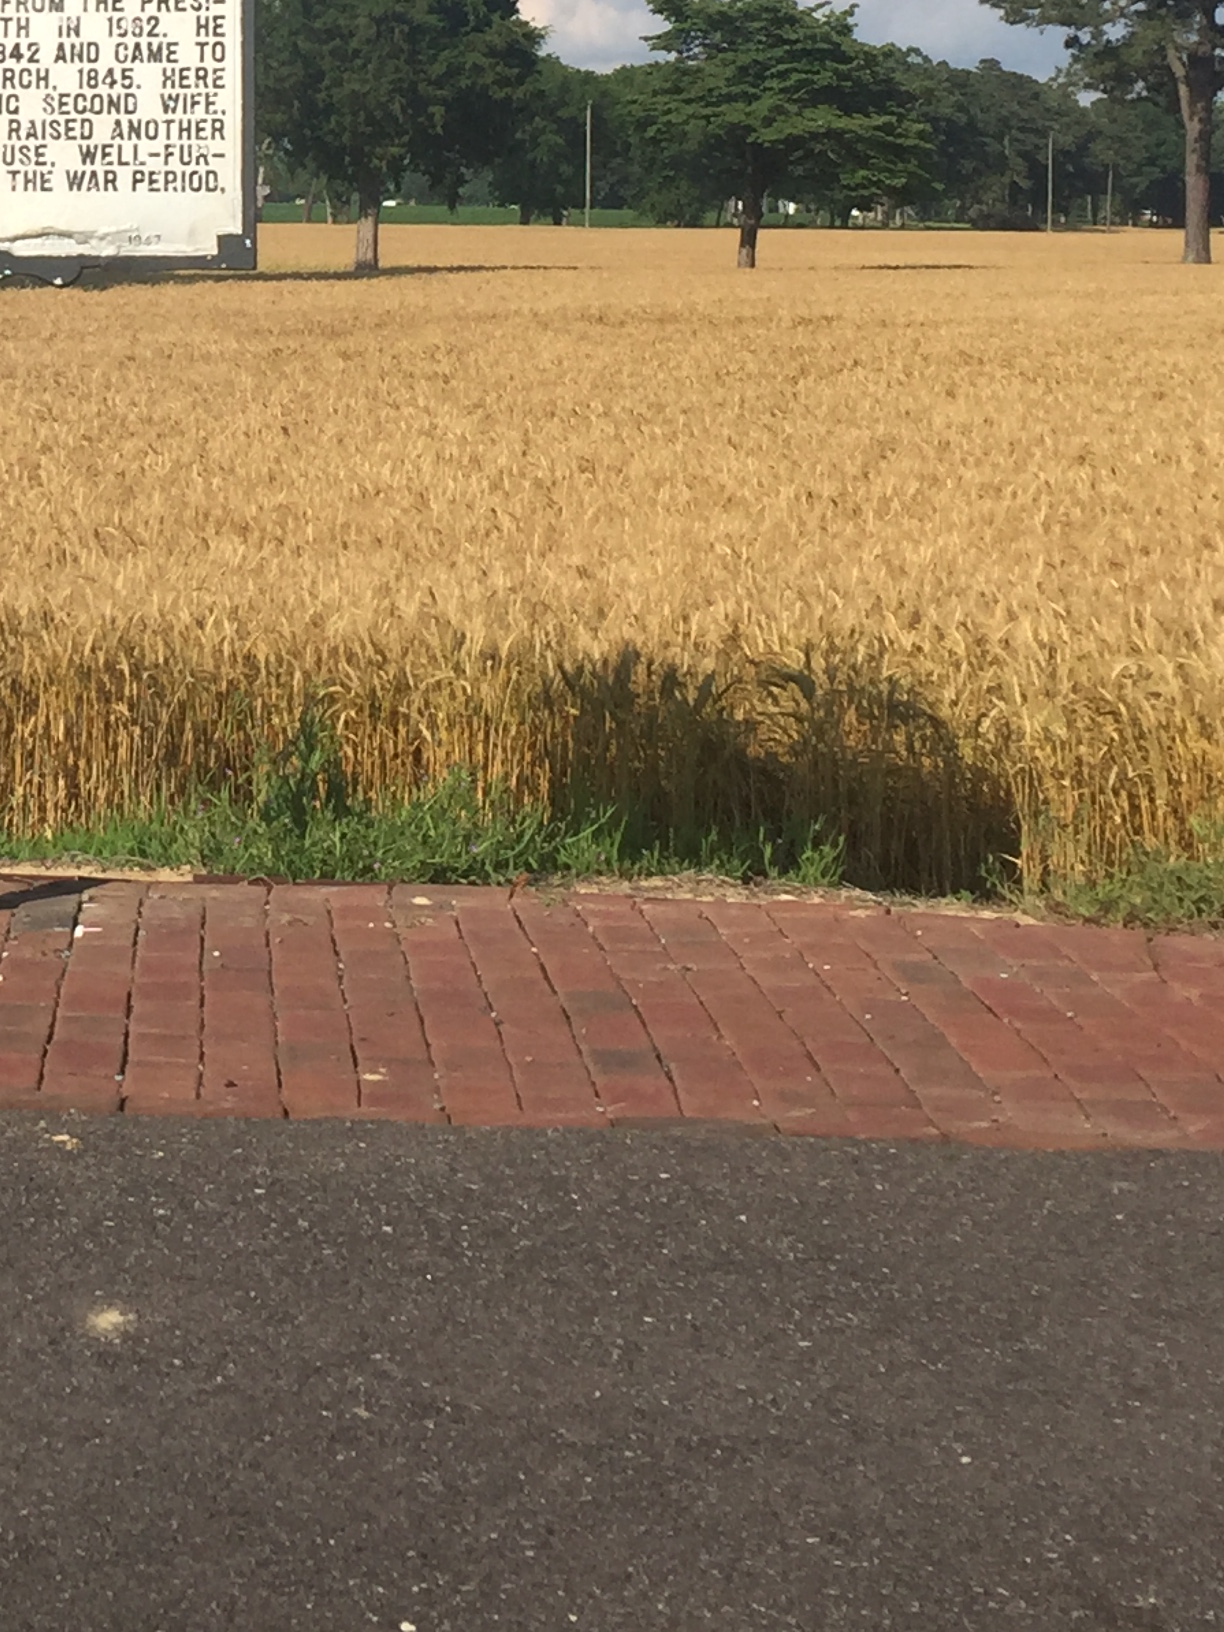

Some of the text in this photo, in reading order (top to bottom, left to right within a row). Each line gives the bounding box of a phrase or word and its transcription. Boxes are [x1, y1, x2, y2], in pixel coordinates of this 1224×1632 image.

[58, 17, 81, 39] IN
[195, 15, 226, 38] HE
[53, 42, 100, 64] AND
[114, 42, 180, 64] CAME
[194, 41, 226, 64] TO
[77, 68, 142, 90] 1845.
[161, 67, 226, 90] HERE
[42, 93, 138, 116] SECOND
[159, 93, 227, 116] WIFE,
[7, 119, 94, 141] RAISED
[110, 119, 226, 141] ANOTHER
[6, 170, 54, 192] THE
[65, 170, 119, 192] WAR
[131, 170, 226, 194] PERIOD,
